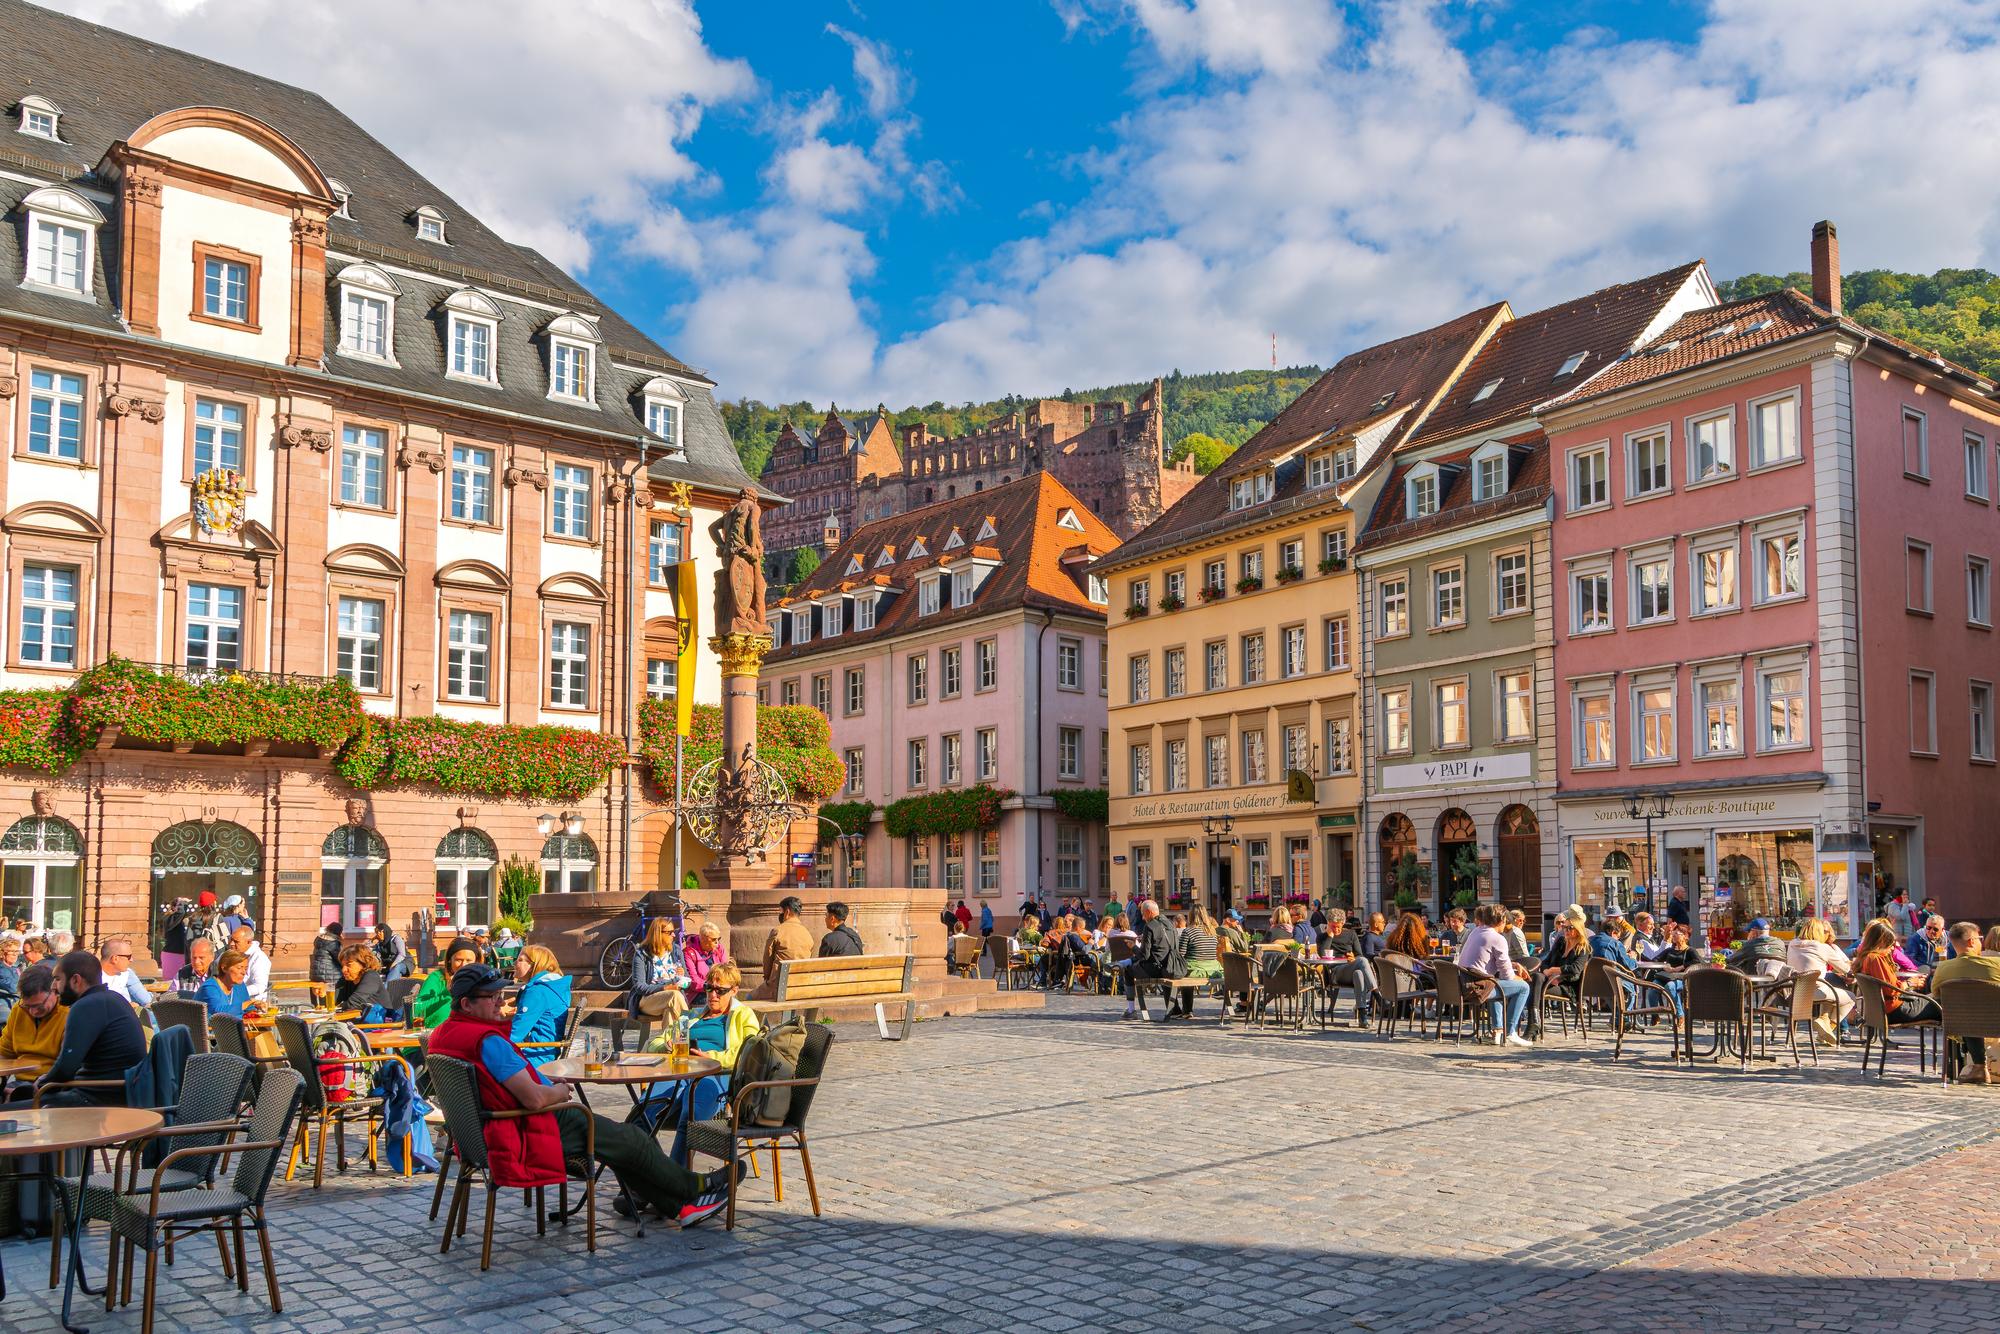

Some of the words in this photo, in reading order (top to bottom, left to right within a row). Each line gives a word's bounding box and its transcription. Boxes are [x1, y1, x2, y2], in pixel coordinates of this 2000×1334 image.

[1441, 762, 1468, 777] PAPI
[203, 806, 216, 816] 10
[1133, 802, 1158, 816] Hotel
[1159, 803, 1167, 815] &
[1168, 798, 1230, 815] Restauration
[1233, 793, 1278, 811] Goldener
[1660, 800, 1776, 818] eschenk-Boutique
